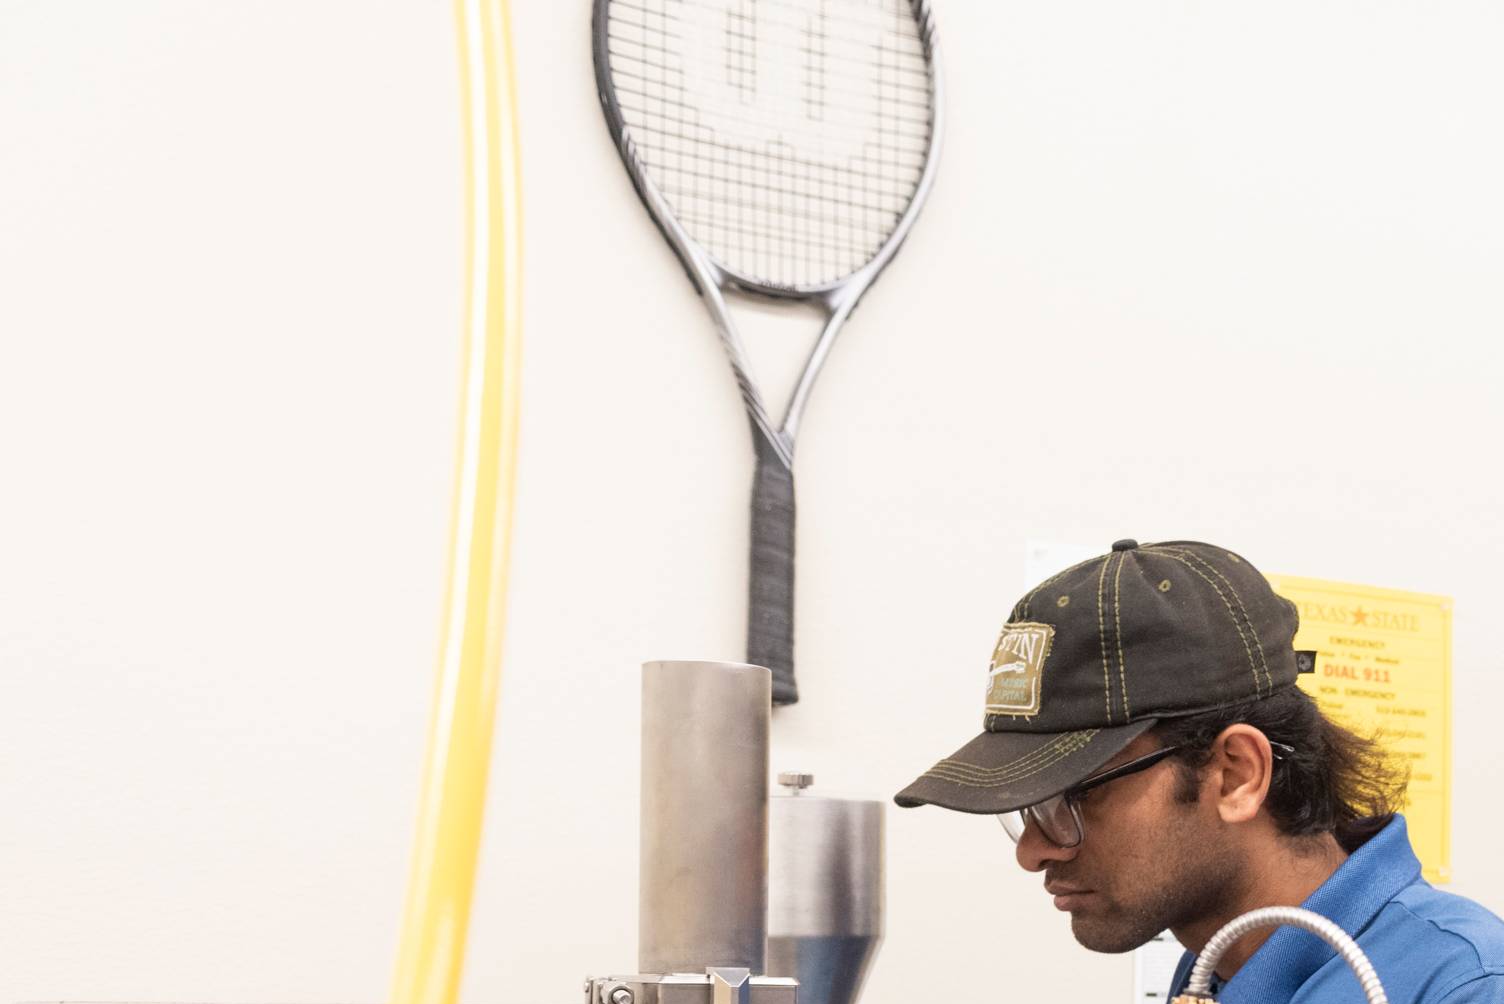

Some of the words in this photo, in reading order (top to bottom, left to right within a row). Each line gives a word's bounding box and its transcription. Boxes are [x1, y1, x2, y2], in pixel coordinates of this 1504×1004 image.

[1372, 610, 1420, 631] STATE
[1324, 664, 1361, 680] DIAL
[1363, 668, 1391, 683] 911
